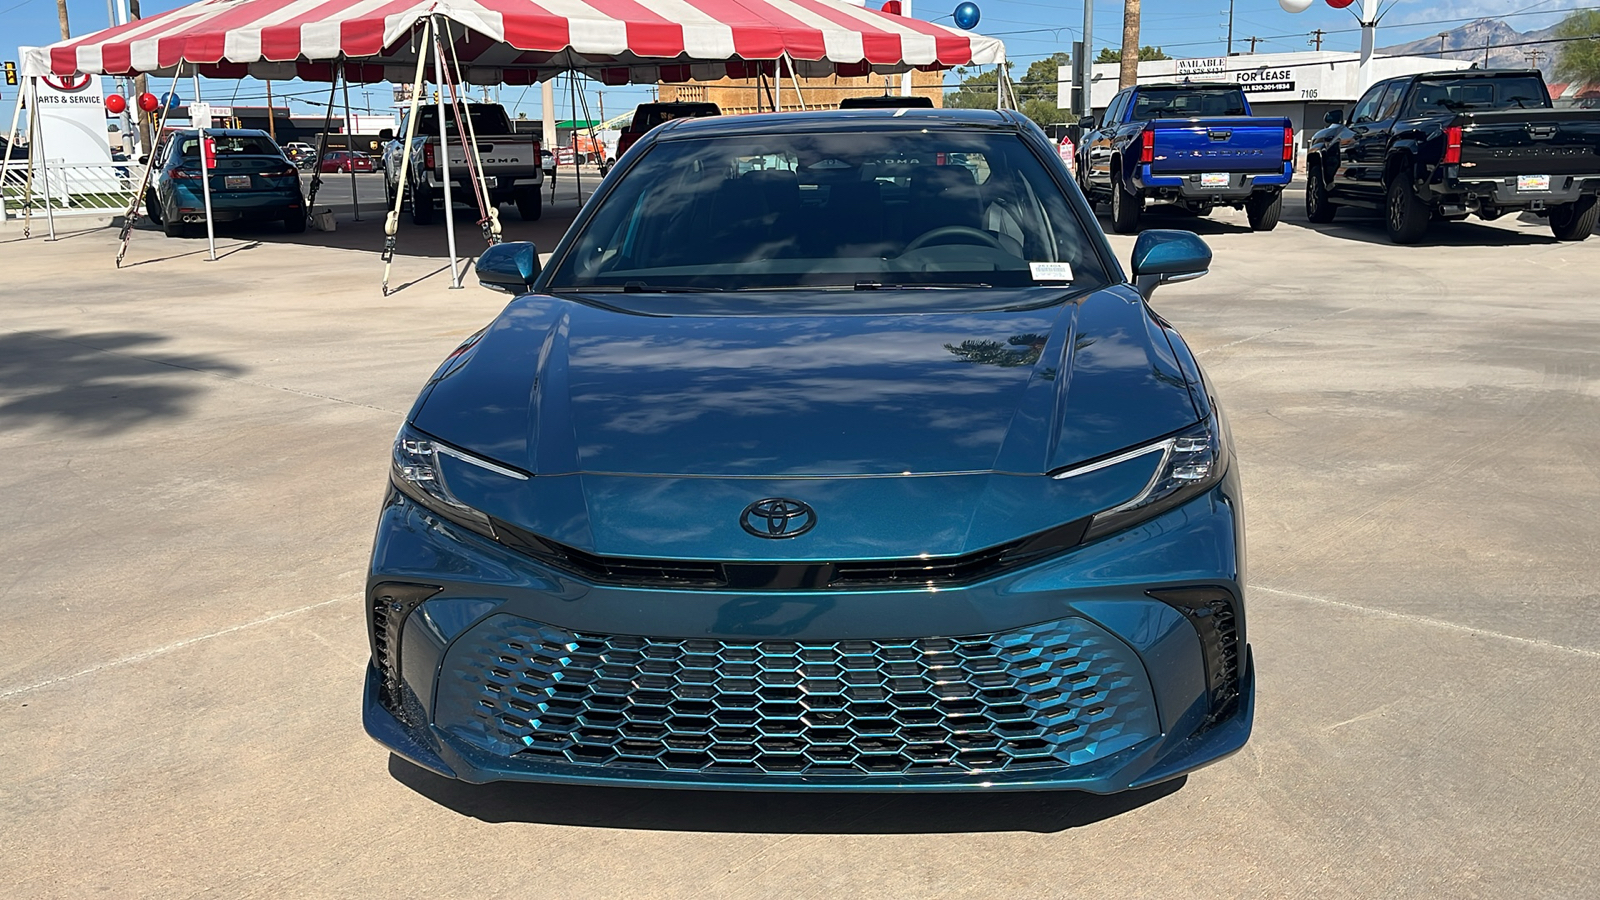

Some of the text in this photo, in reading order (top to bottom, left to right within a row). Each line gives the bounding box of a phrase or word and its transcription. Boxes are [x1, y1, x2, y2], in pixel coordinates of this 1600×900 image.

[1178, 58, 1225, 68] AVAILABLE
[1236, 72, 1257, 82] FOR
[1260, 70, 1291, 81] LEASE
[1301, 89, 1318, 99] 7105
